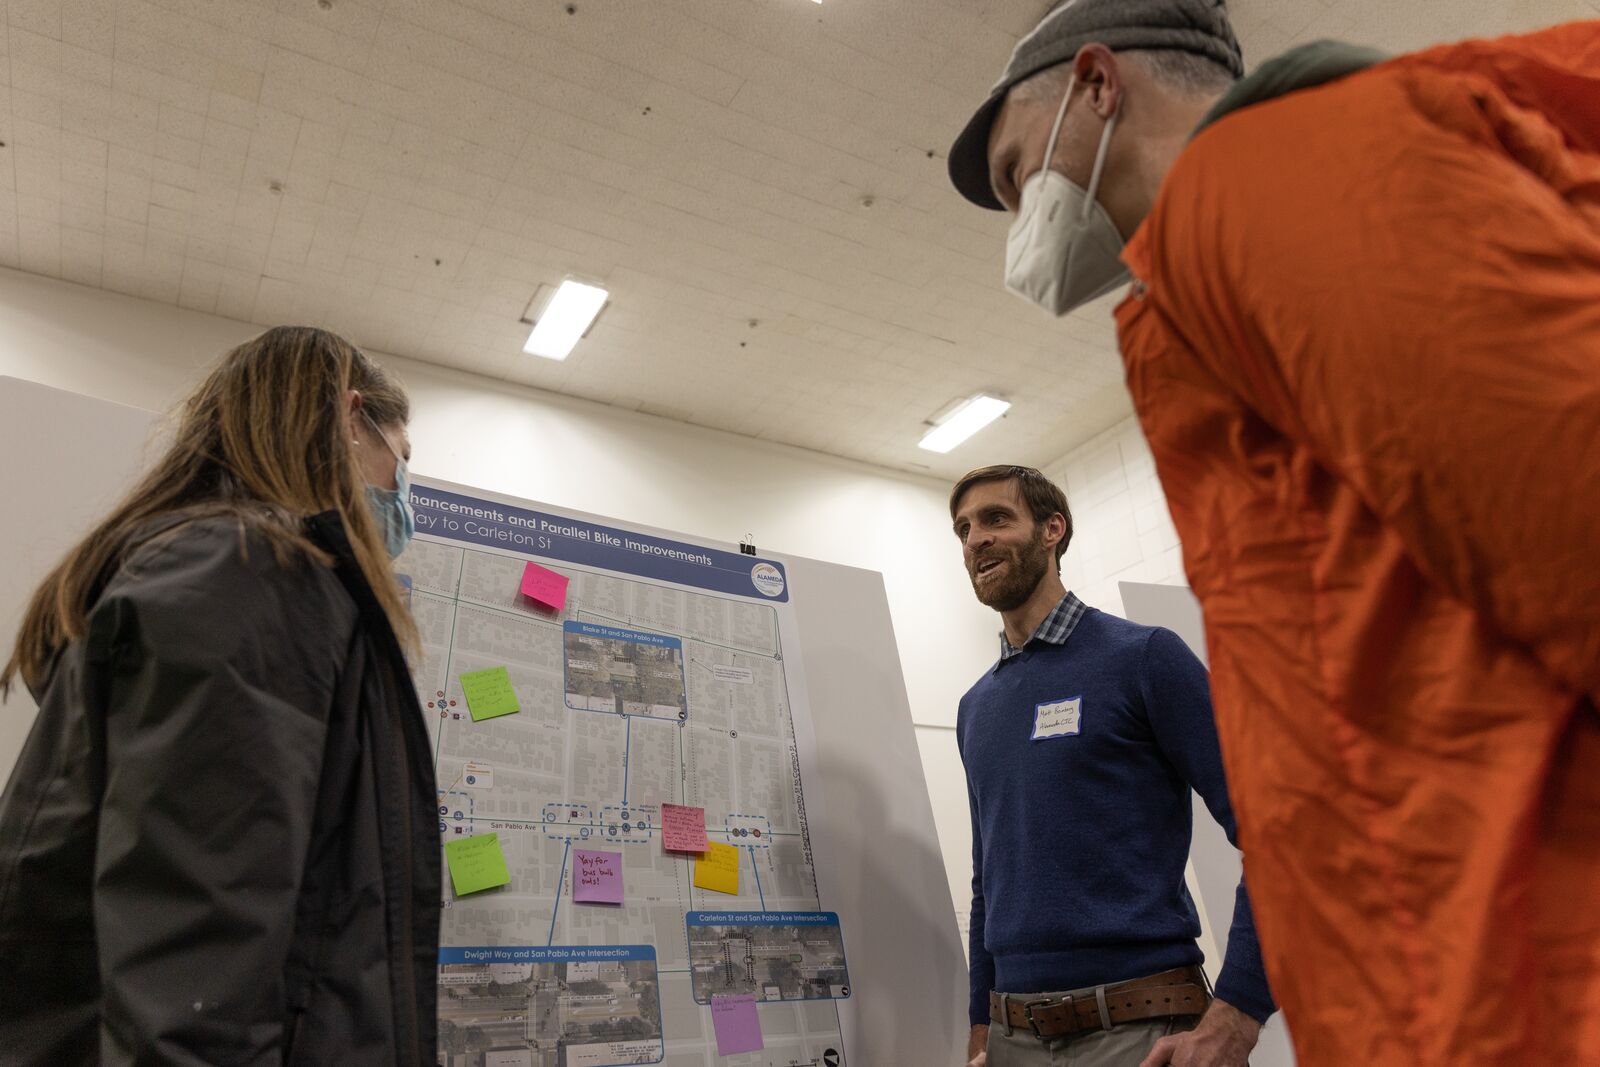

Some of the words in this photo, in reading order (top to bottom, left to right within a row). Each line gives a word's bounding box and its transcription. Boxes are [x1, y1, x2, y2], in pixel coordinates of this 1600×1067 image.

[413, 513, 438, 529] ay
[442, 516, 459, 531] to
[464, 521, 534, 546] Carleton
[538, 536, 552, 550] St
[508, 515, 536, 529] and
[540, 520, 590, 540] Parallel
[594, 532, 621, 547] Bike
[625, 538, 712, 566] Improvements
[756, 574, 783, 583] ALAMEDA
[582, 625, 600, 634] Blake
[621, 631, 633, 639] San
[634, 633, 651, 641] Pablo
[796, 795, 804, 815] Derby
[800, 821, 809, 851] Segment
[578, 854, 593, 868] Yay
[594, 856, 609, 866] for
[582, 868, 596, 877] bus
[598, 868, 614, 877] bulb
[699, 914, 727, 922] Carleton
[728, 914, 734, 922] St
[735, 914, 748, 922] and
[749, 914, 760, 922] San
[762, 914, 780, 922] Pablo
[464, 950, 492, 960] Dwight
[494, 950, 512, 959] Way
[514, 950, 530, 958] and
[531, 950, 546, 958] San
[547, 949, 569, 958] Pablo
[570, 949, 586, 957] Ave
[588, 949, 630, 957] Intersection
